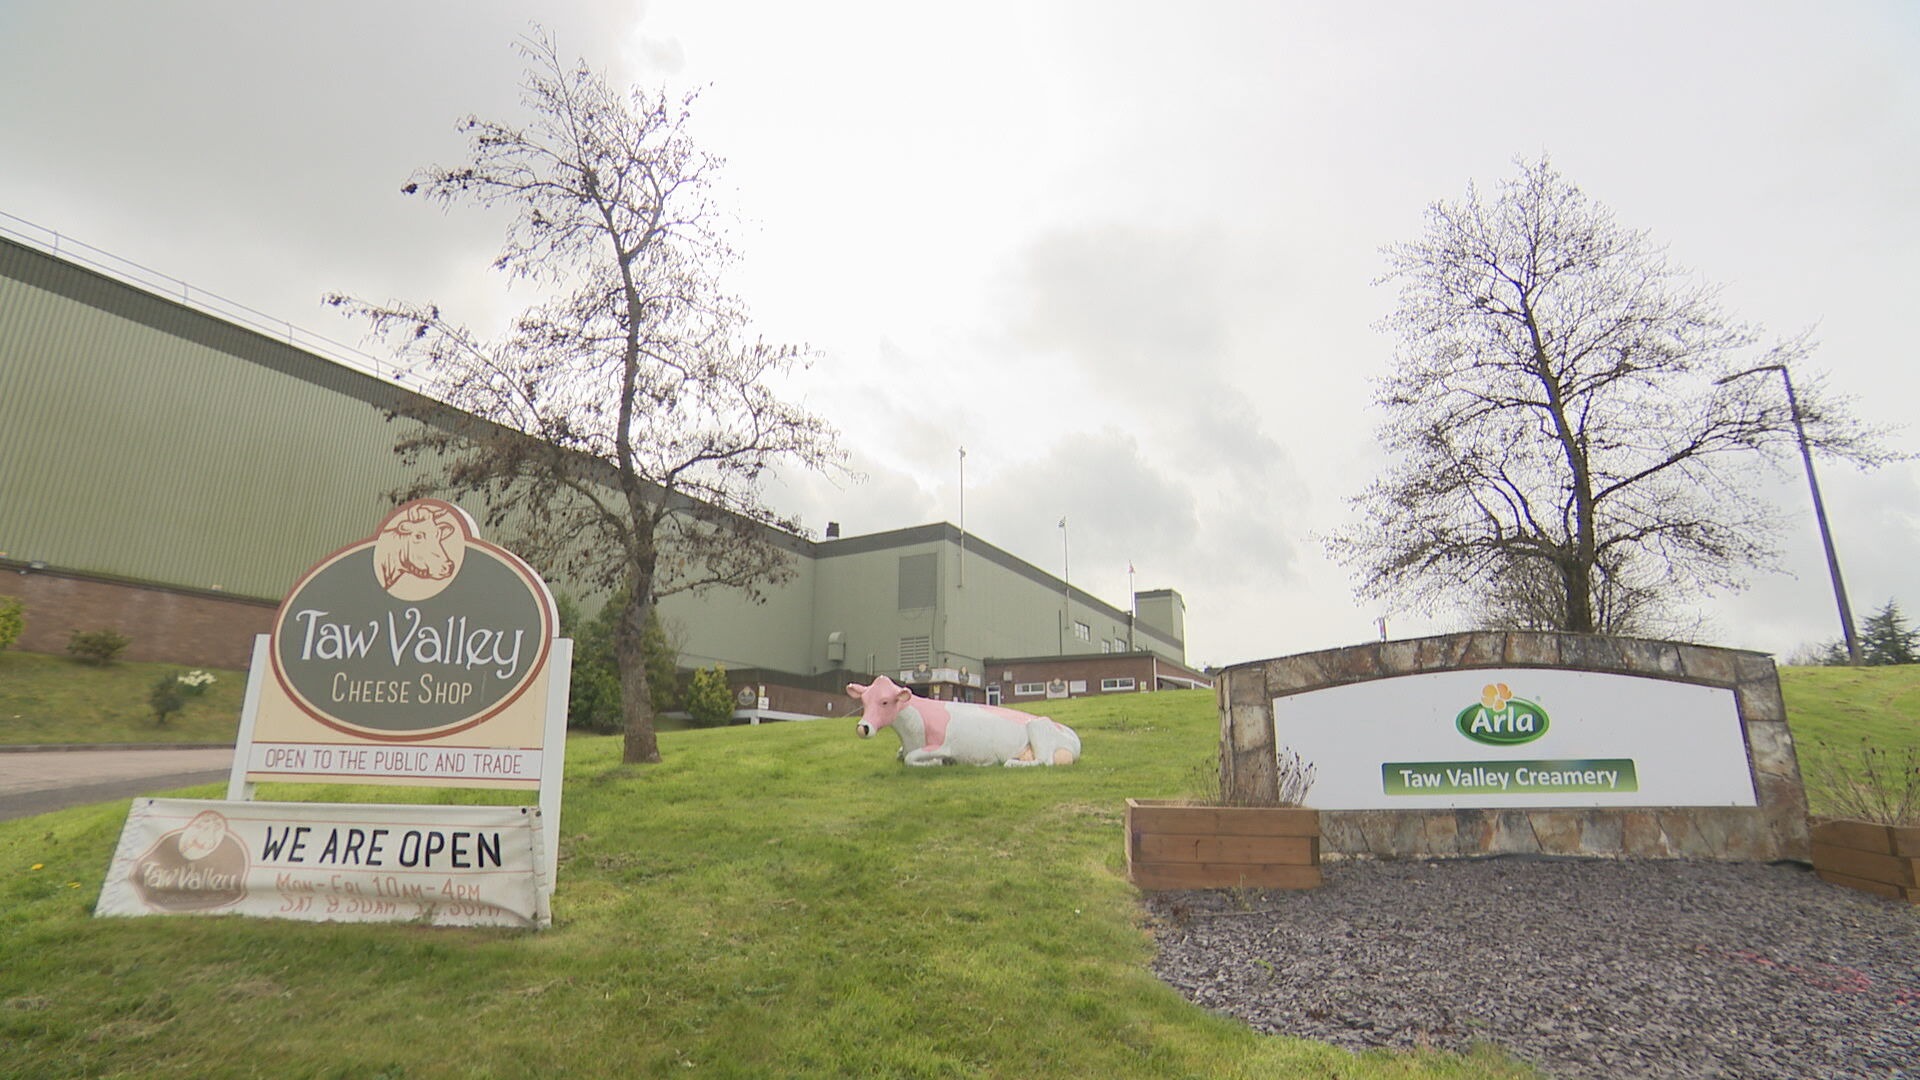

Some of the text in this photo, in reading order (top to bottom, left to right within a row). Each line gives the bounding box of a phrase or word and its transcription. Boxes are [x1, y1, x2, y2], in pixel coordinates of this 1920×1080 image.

[296, 607, 524, 679] Taw Valley
[331, 672, 473, 705] CHEESE SHOP
[1470, 706, 1534, 733] Arla
[265, 748, 523, 774] OPEN TO THE PUBLIC AND TRADE
[1399, 767, 1618, 790] Taw Valley Creamery
[262, 826, 502, 868] WE ARE OPEN
